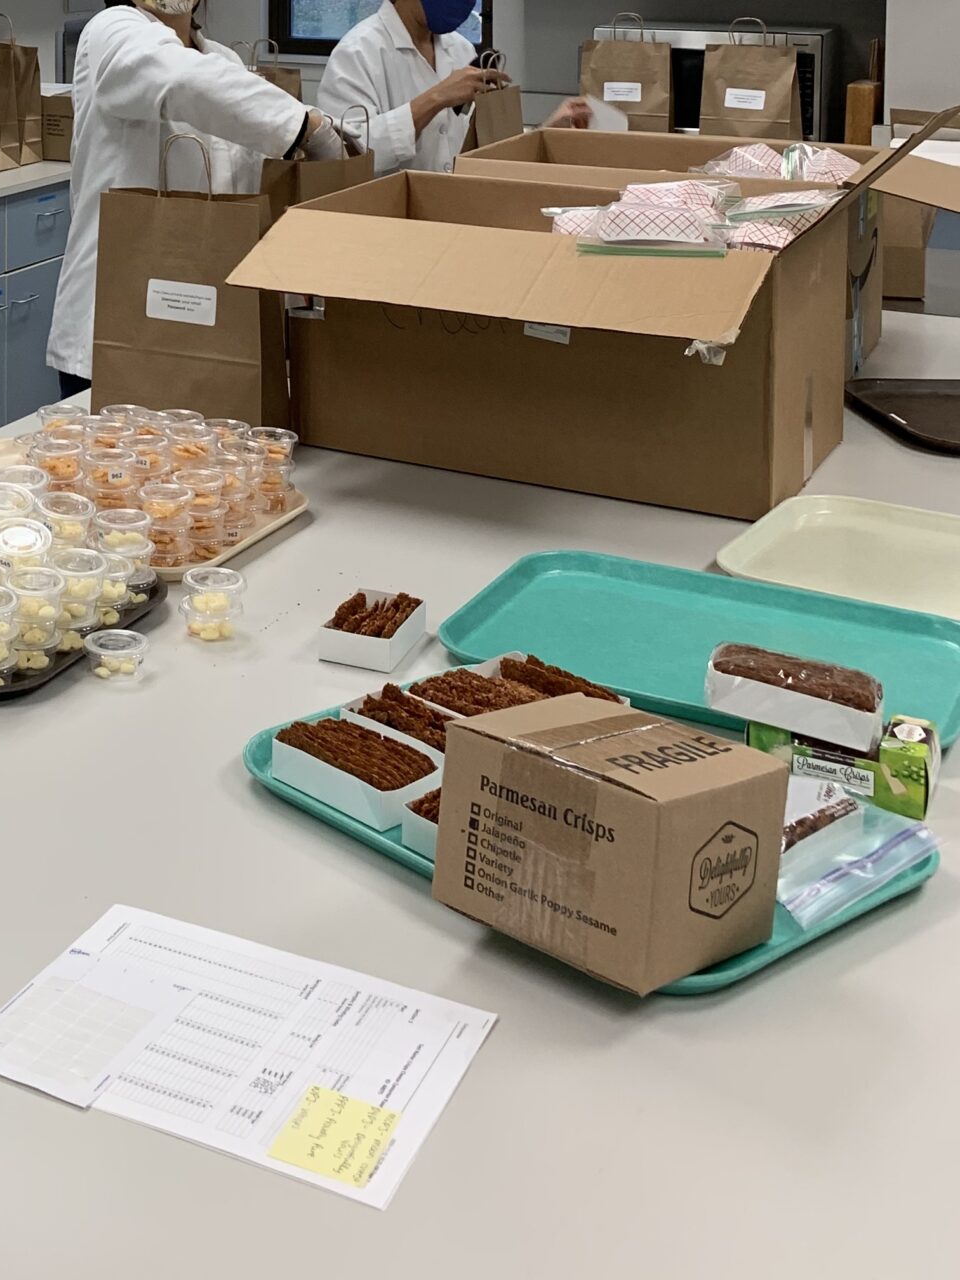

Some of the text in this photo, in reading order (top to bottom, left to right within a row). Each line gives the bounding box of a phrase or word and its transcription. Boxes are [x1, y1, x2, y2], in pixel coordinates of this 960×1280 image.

[605, 736, 732, 775] FRAGILE
[797, 756, 837, 775] Parmesan
[839, 766, 870, 784] Crisps
[480, 775, 616, 843] Parmesan Crisps
[483, 807, 523, 832] Original
[481, 823, 526, 849] Jalapeño
[480, 838, 522, 863] Chipotle
[479, 852, 514, 876] Variety
[476, 882, 505, 902] Other
[477, 868, 618, 937] Onion Garlic Poppy Sesame
